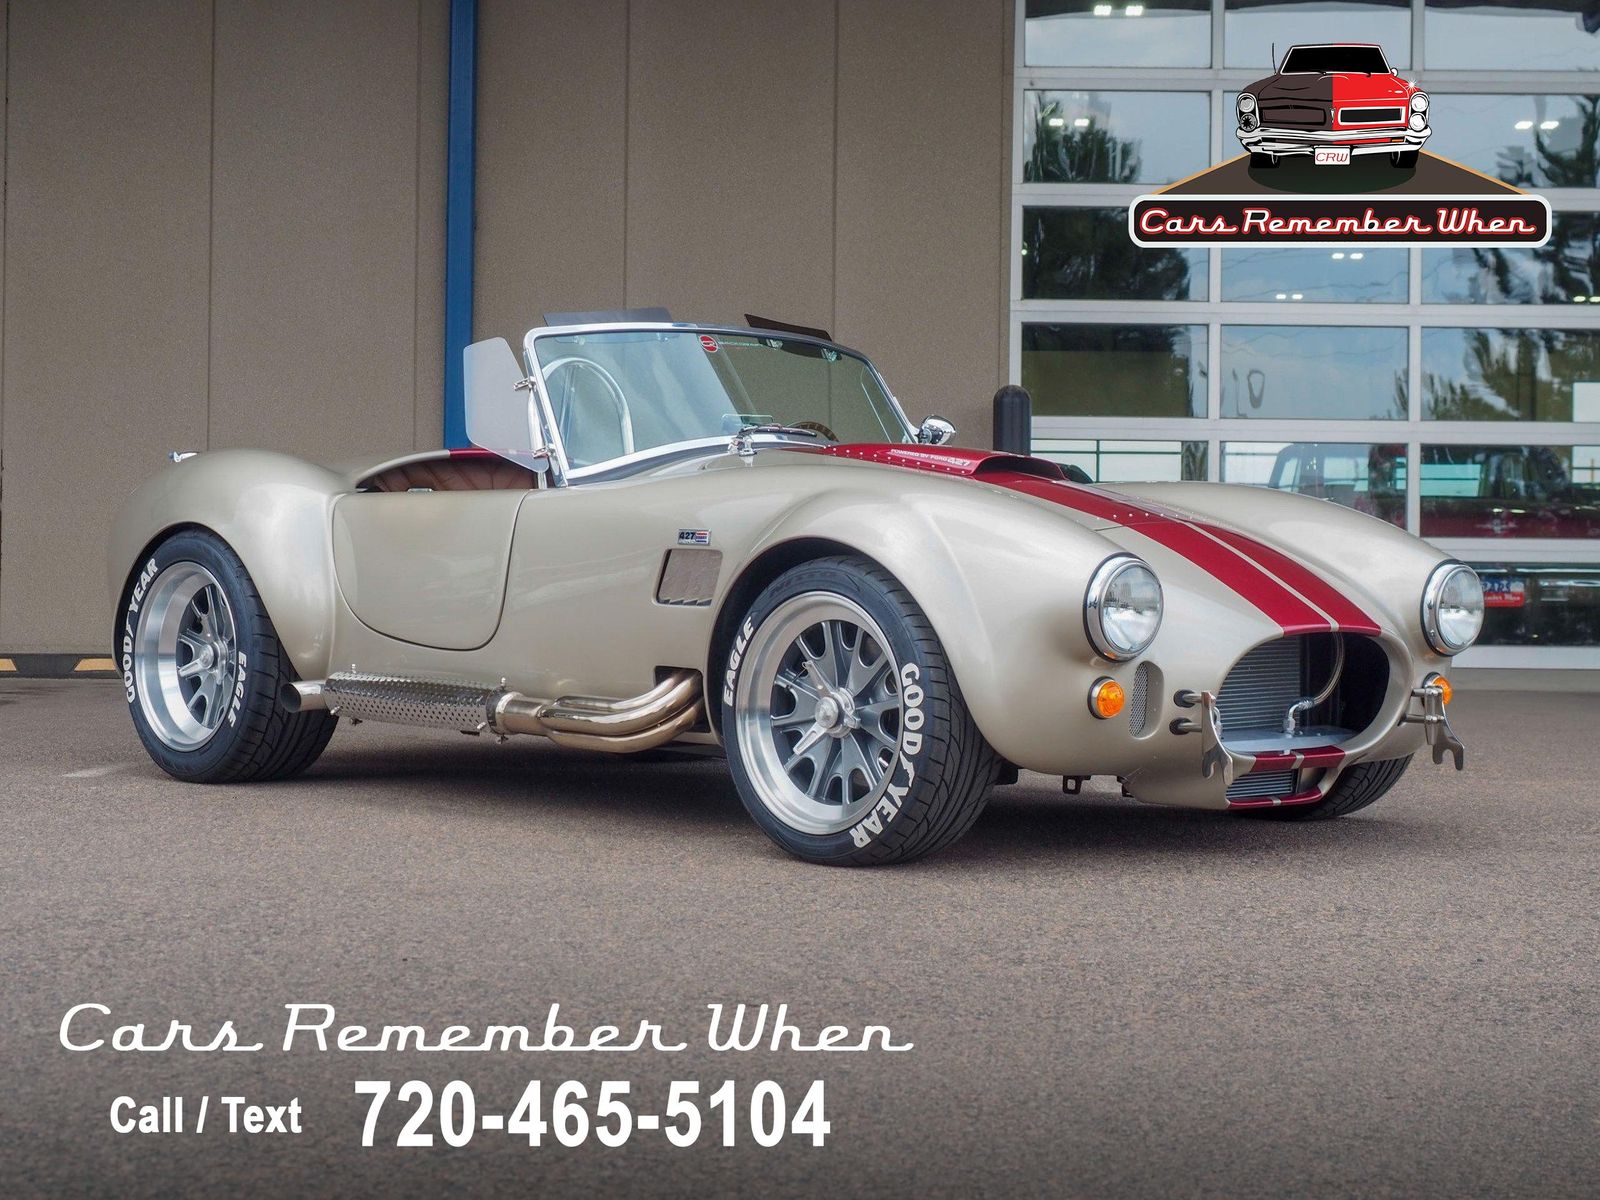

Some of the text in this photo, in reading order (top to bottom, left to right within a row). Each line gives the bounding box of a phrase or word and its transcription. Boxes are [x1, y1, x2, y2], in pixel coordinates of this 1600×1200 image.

[947, 456, 970, 467] 427
[679, 531, 696, 540] 427
[723, 616, 755, 707] EAGLE
[228, 651, 247, 728] EAGLE
